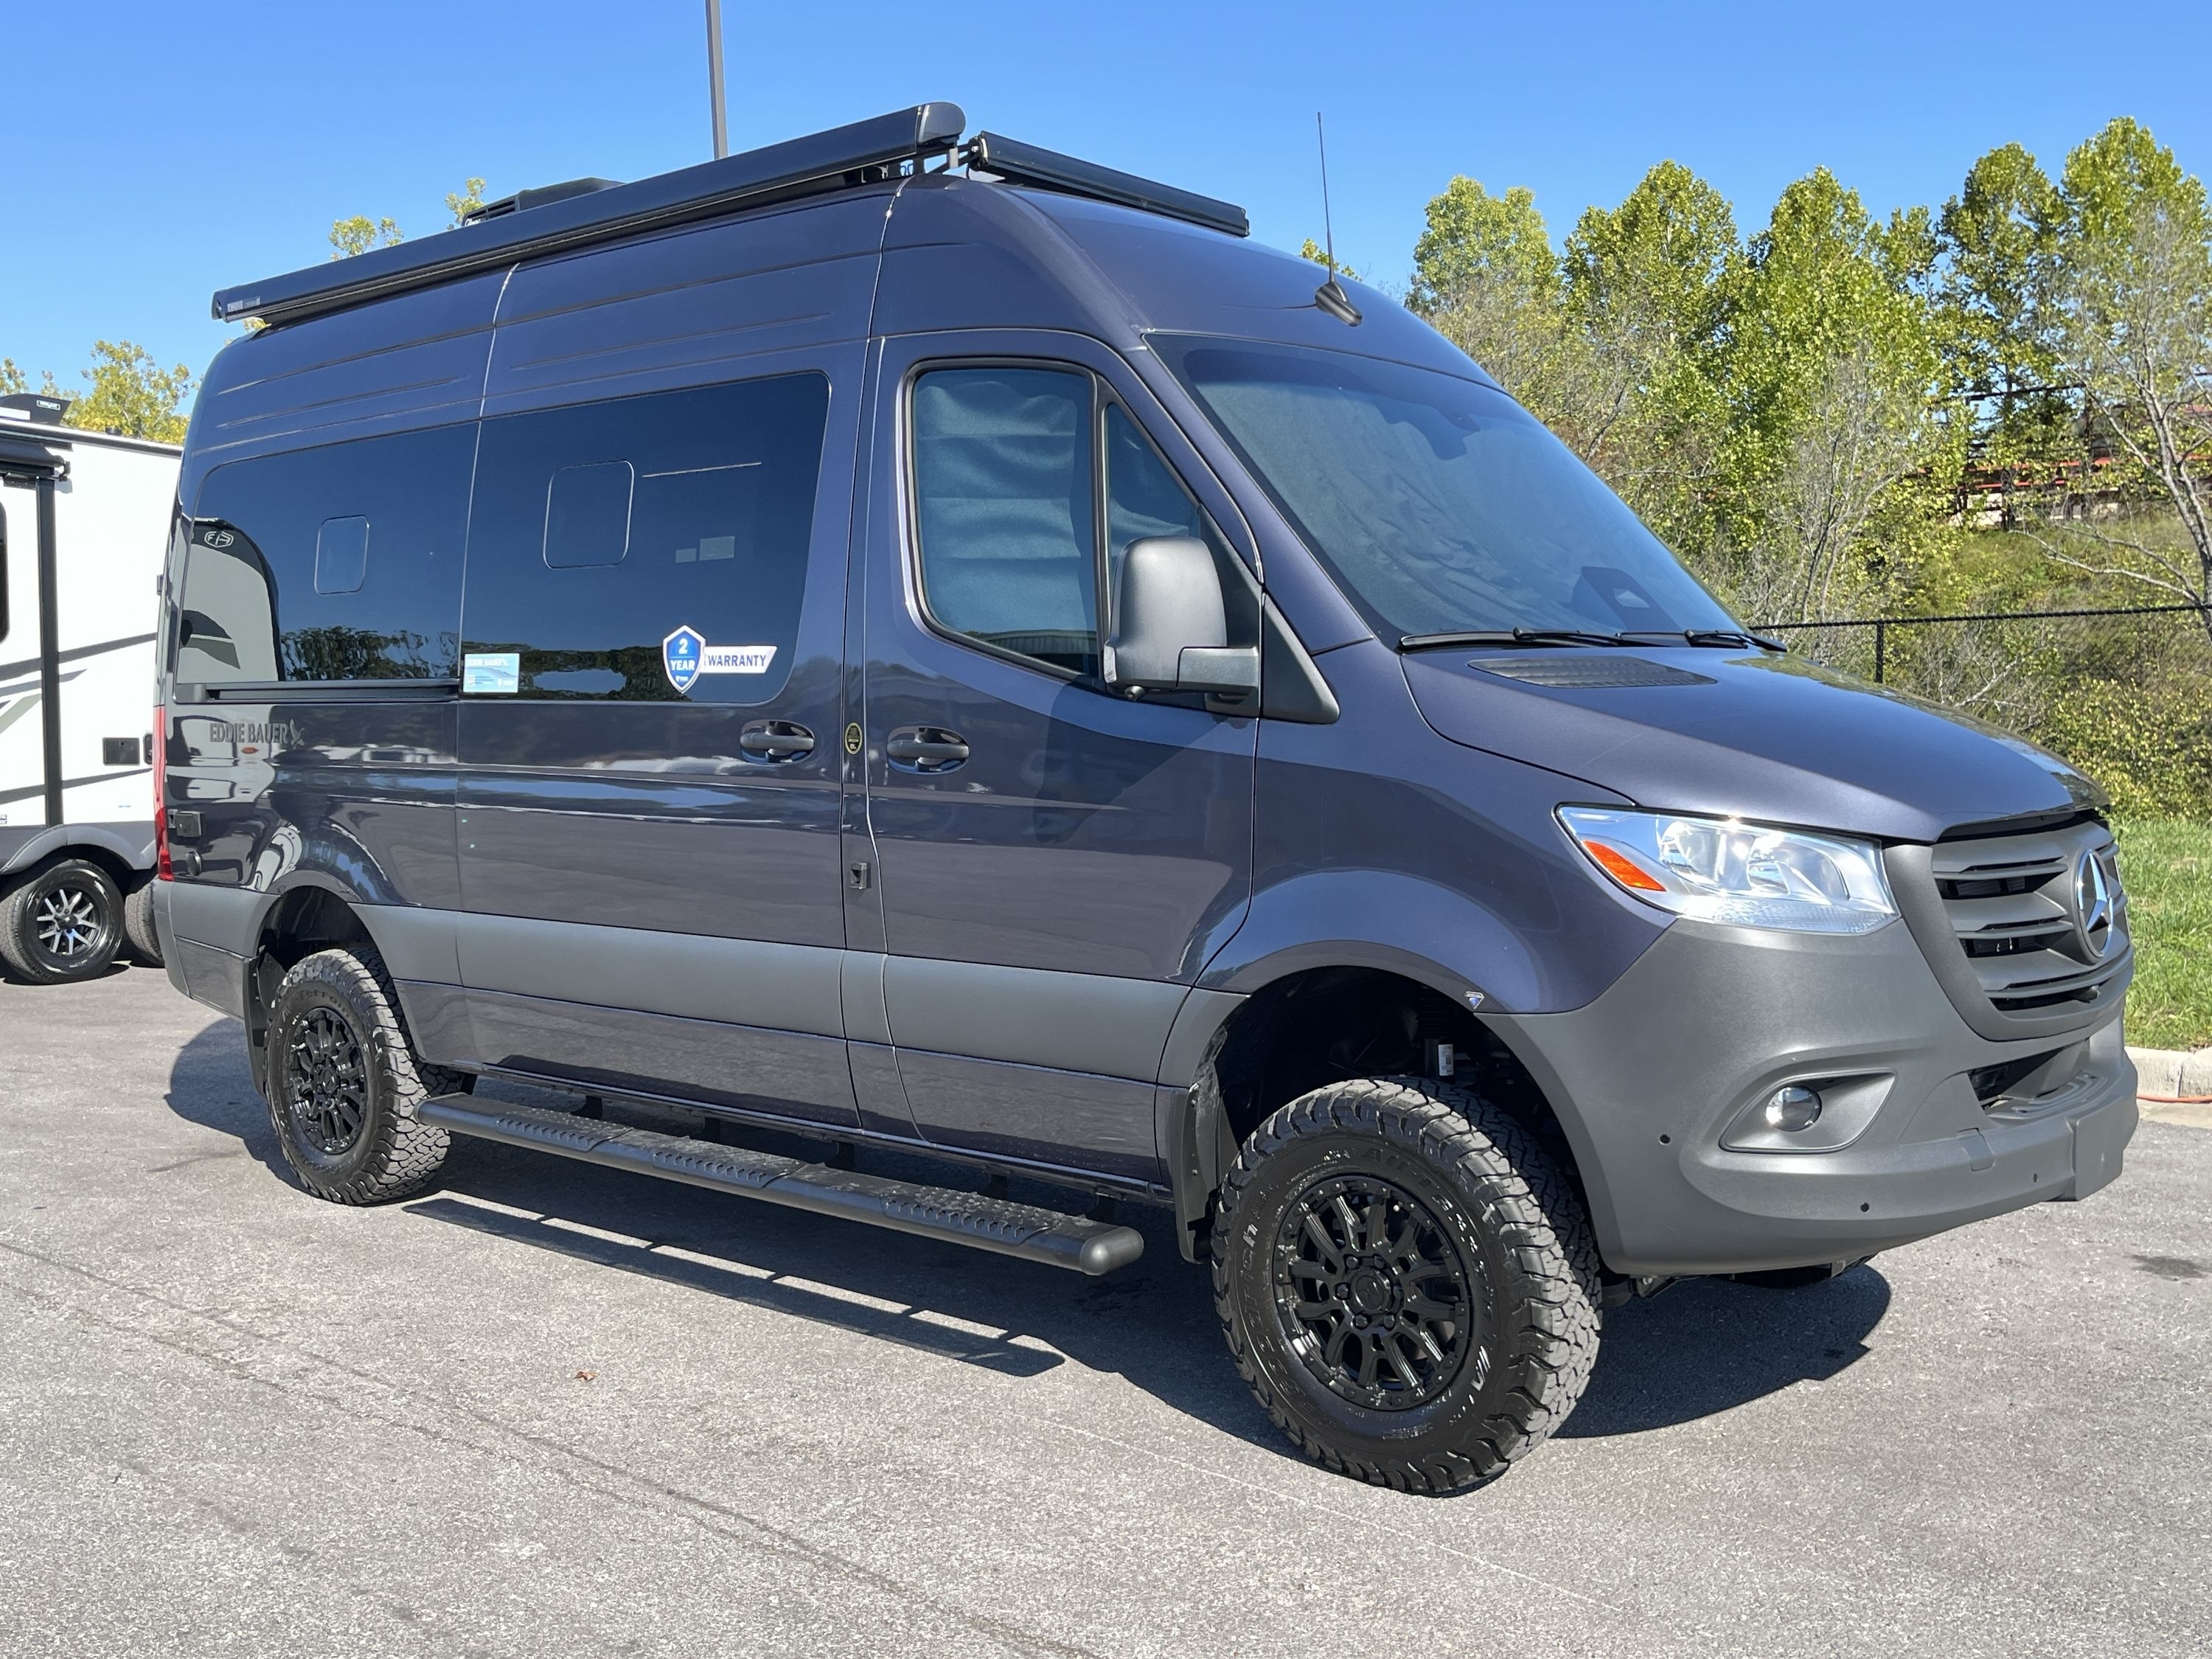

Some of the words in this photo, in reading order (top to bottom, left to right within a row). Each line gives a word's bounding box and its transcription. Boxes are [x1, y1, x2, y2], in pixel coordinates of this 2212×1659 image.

[678, 638, 689, 654] 2
[670, 659, 696, 671] YEAR
[708, 655, 767, 667] WARRANTY
[209, 723, 245, 743] EDDIE
[248, 723, 288, 744] BAUER
